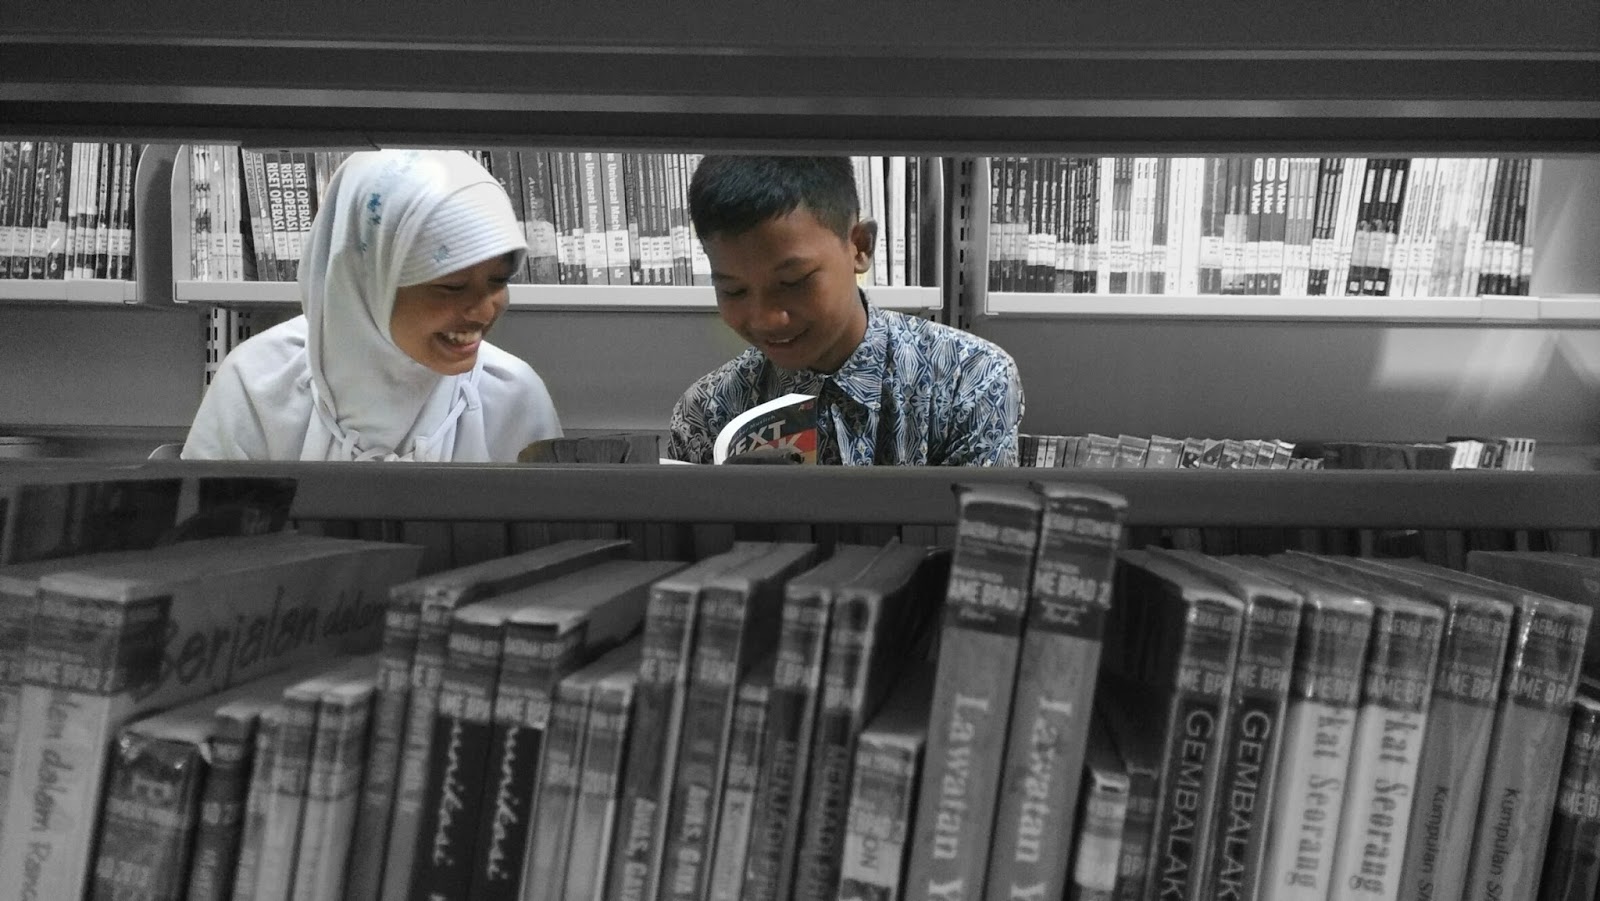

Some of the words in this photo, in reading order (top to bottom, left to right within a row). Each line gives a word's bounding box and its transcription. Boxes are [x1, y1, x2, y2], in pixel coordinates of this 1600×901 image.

[266, 162, 281, 188] RISET
[280, 163, 294, 189] RISET
[294, 163, 308, 188] RISET
[586, 163, 598, 205] Universal
[608, 163, 619, 205] Universal
[269, 189, 286, 231] OPERASI
[284, 190, 299, 231] OPERASI
[297, 189, 311, 232] OPERASI
[932, 693, 990, 861] Lawatan
[1015, 697, 1073, 864] Lawatan
[1284, 773, 1341, 889] Seorang
[1348, 778, 1409, 896] Seorang
[1421, 785, 1451, 874] Kumpulan
[1489, 787, 1521, 877] Kumpulan
